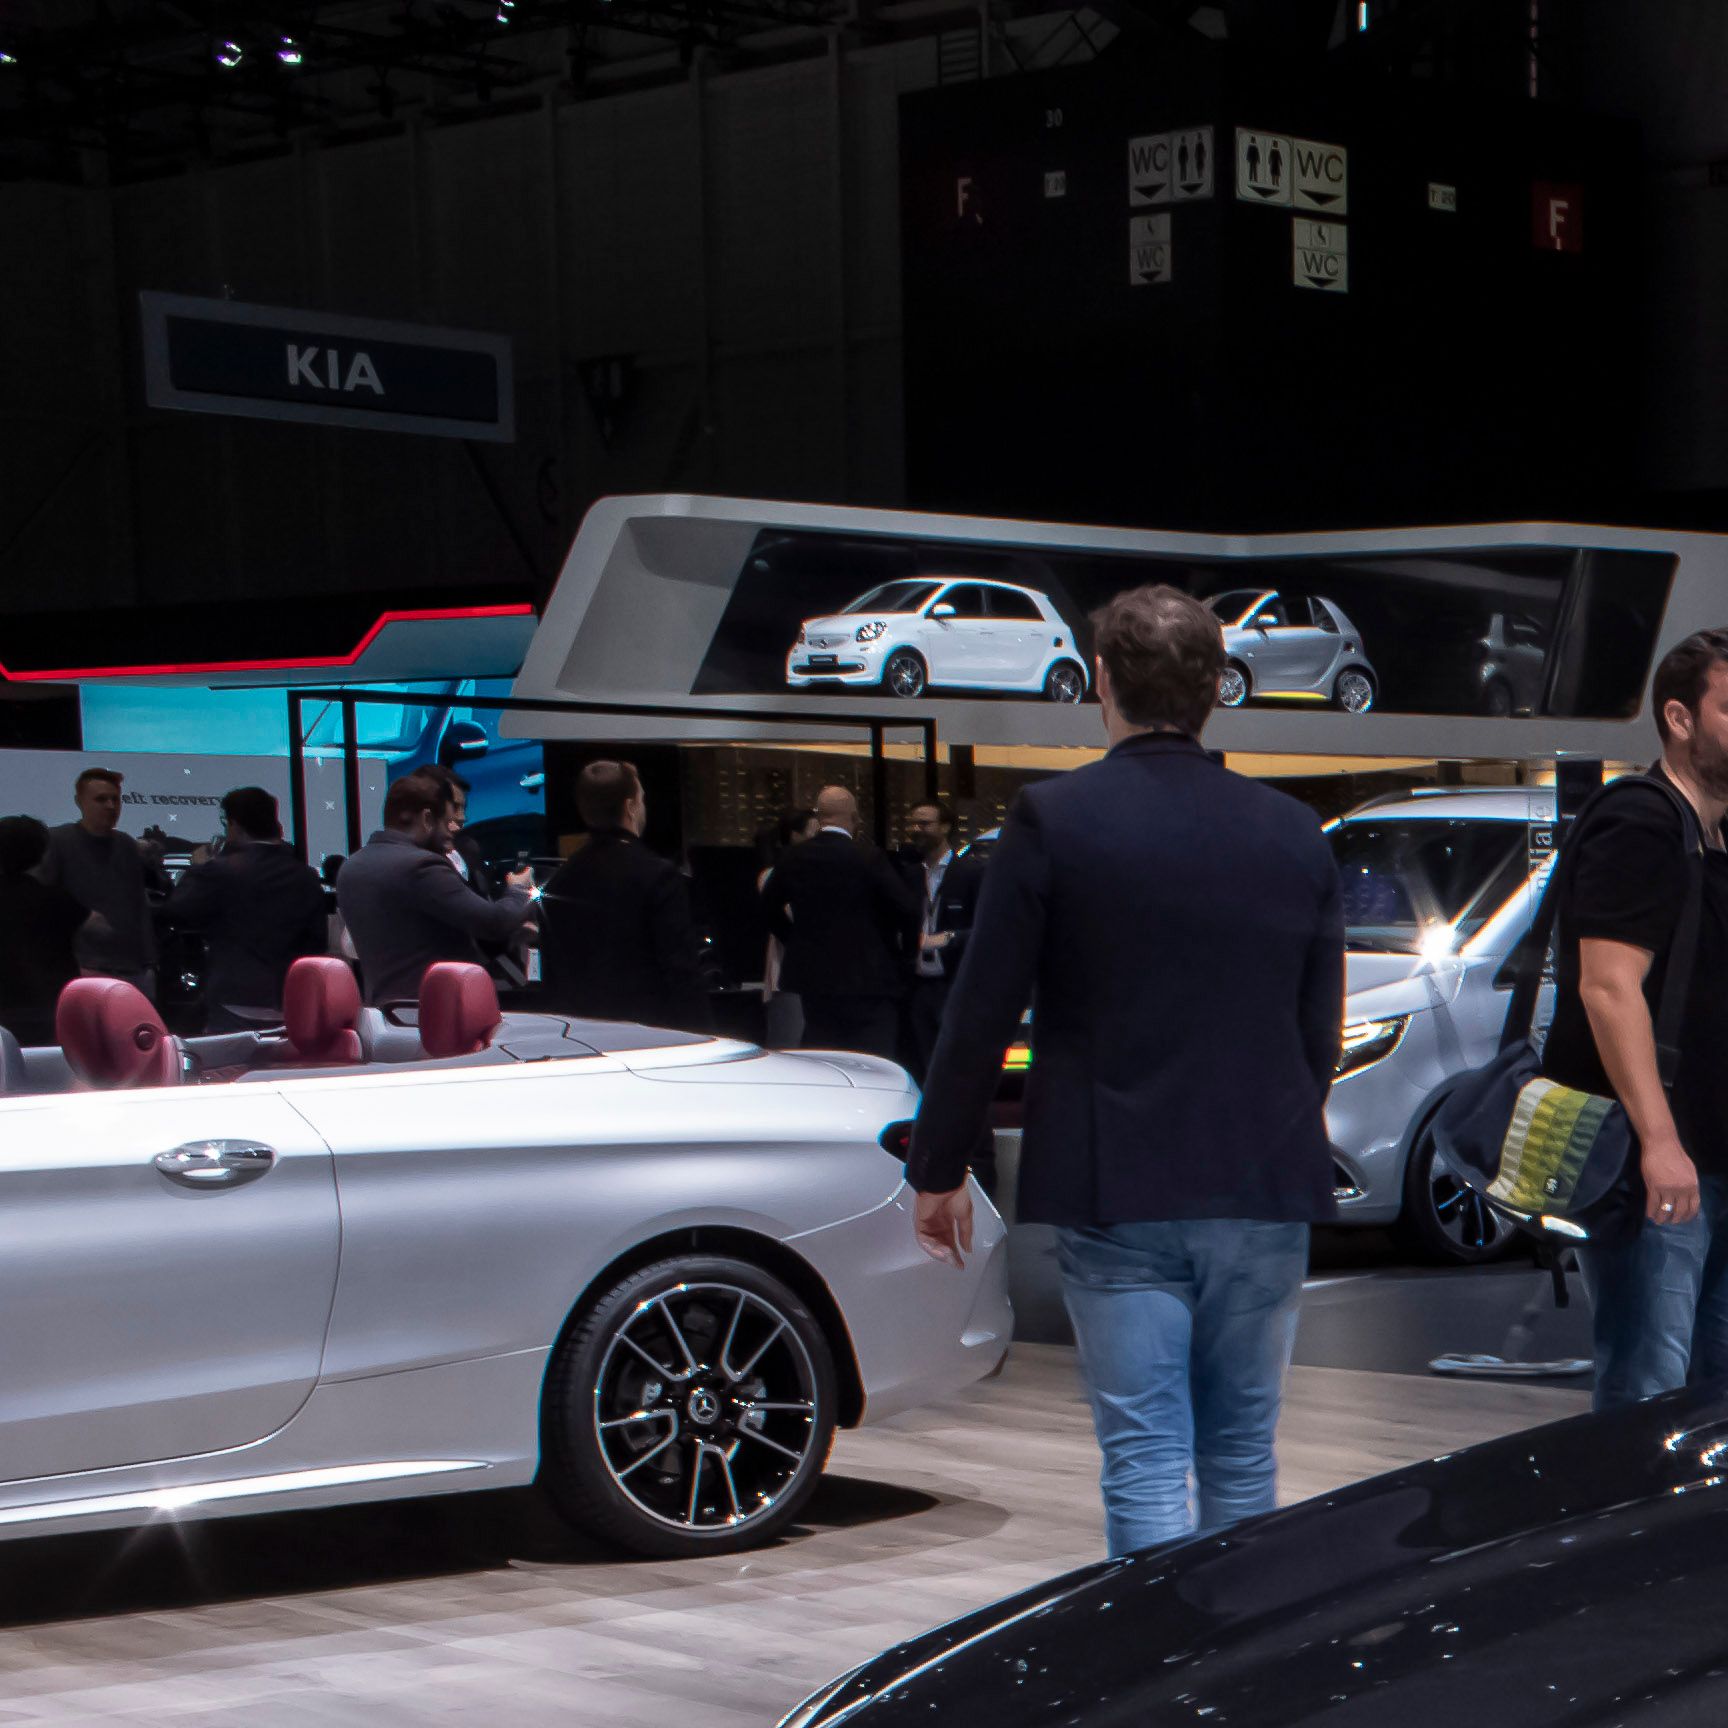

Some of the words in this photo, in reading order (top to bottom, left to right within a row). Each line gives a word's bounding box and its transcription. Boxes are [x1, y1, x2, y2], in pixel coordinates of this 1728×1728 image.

[1131, 143, 1168, 174] WC
[1296, 149, 1344, 183] WC
[1137, 246, 1166, 270] WC
[1304, 253, 1338, 277] WC
[286, 343, 386, 396] KIA
